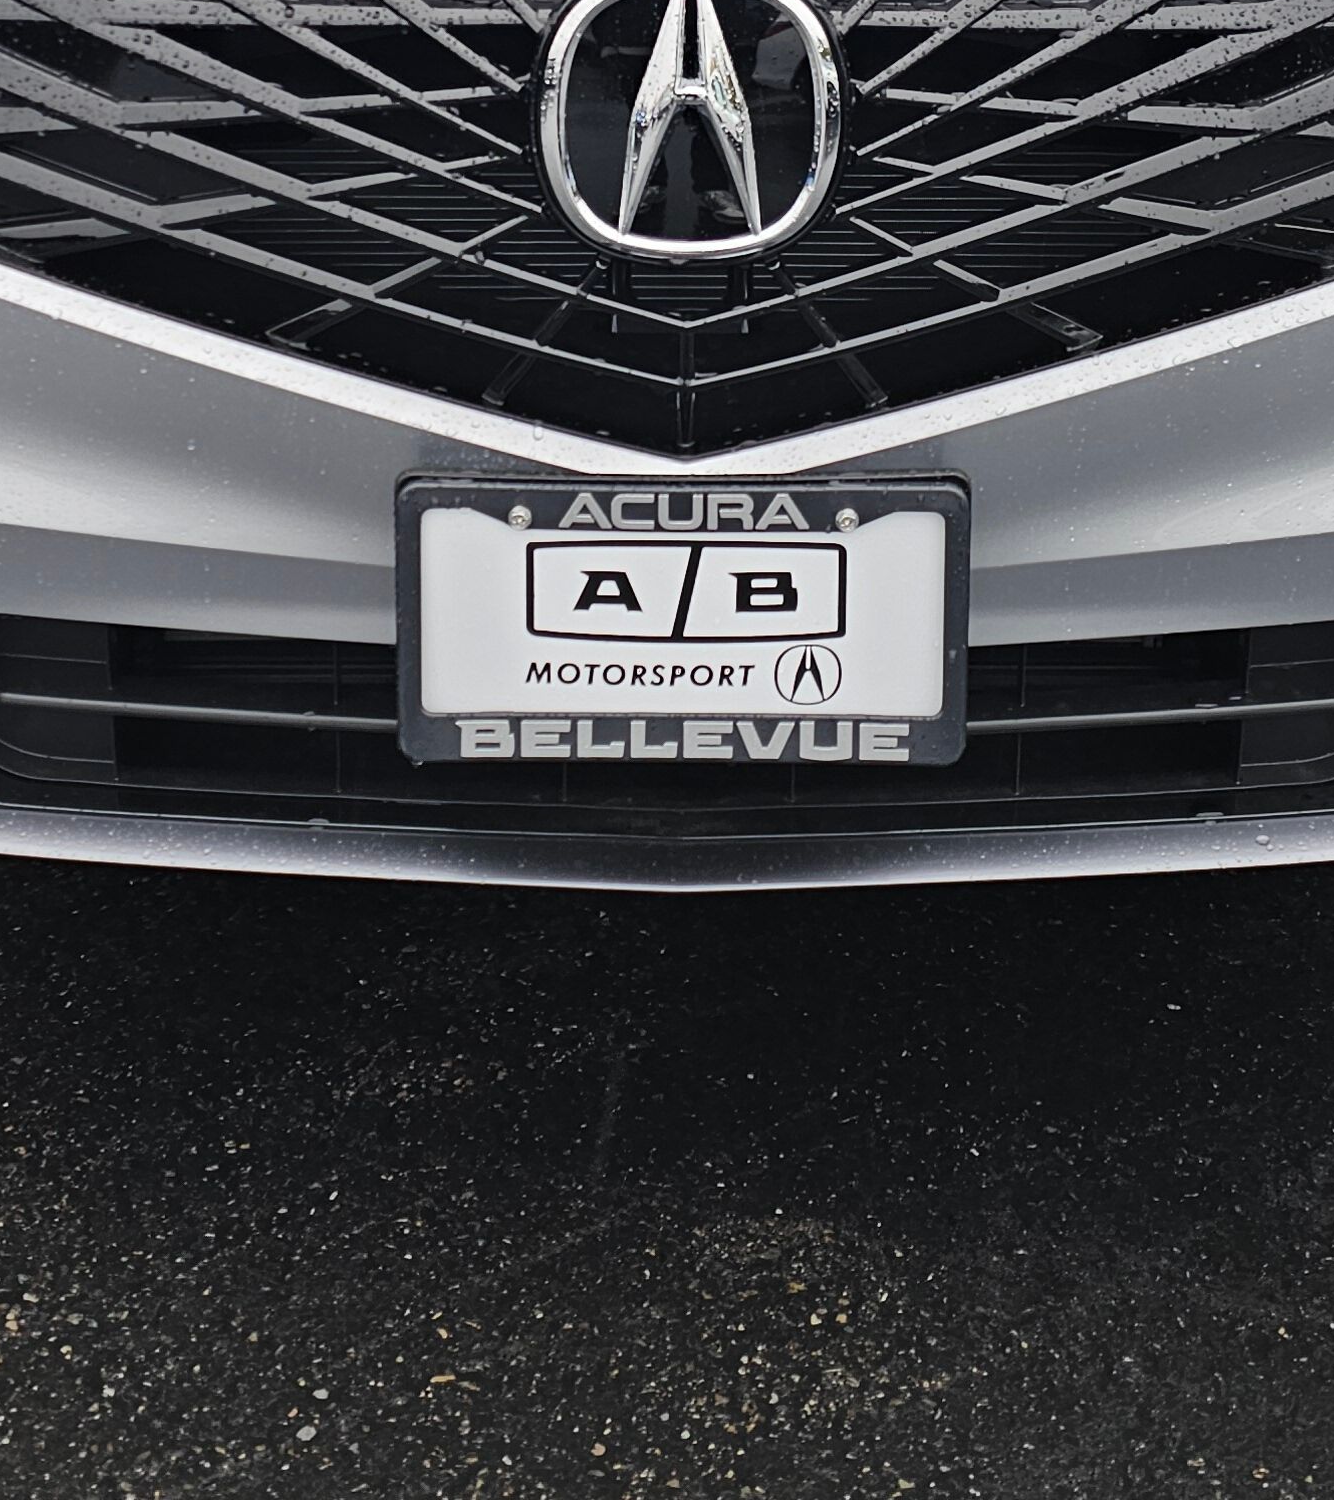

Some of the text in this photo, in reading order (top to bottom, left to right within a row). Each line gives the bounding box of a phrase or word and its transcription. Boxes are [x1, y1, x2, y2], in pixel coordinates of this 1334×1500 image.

[559, 493, 810, 532] ACURA
[573, 570, 798, 612] A B
[525, 661, 756, 688] MOTORSPORT
[455, 719, 910, 762] BELLEVUE
